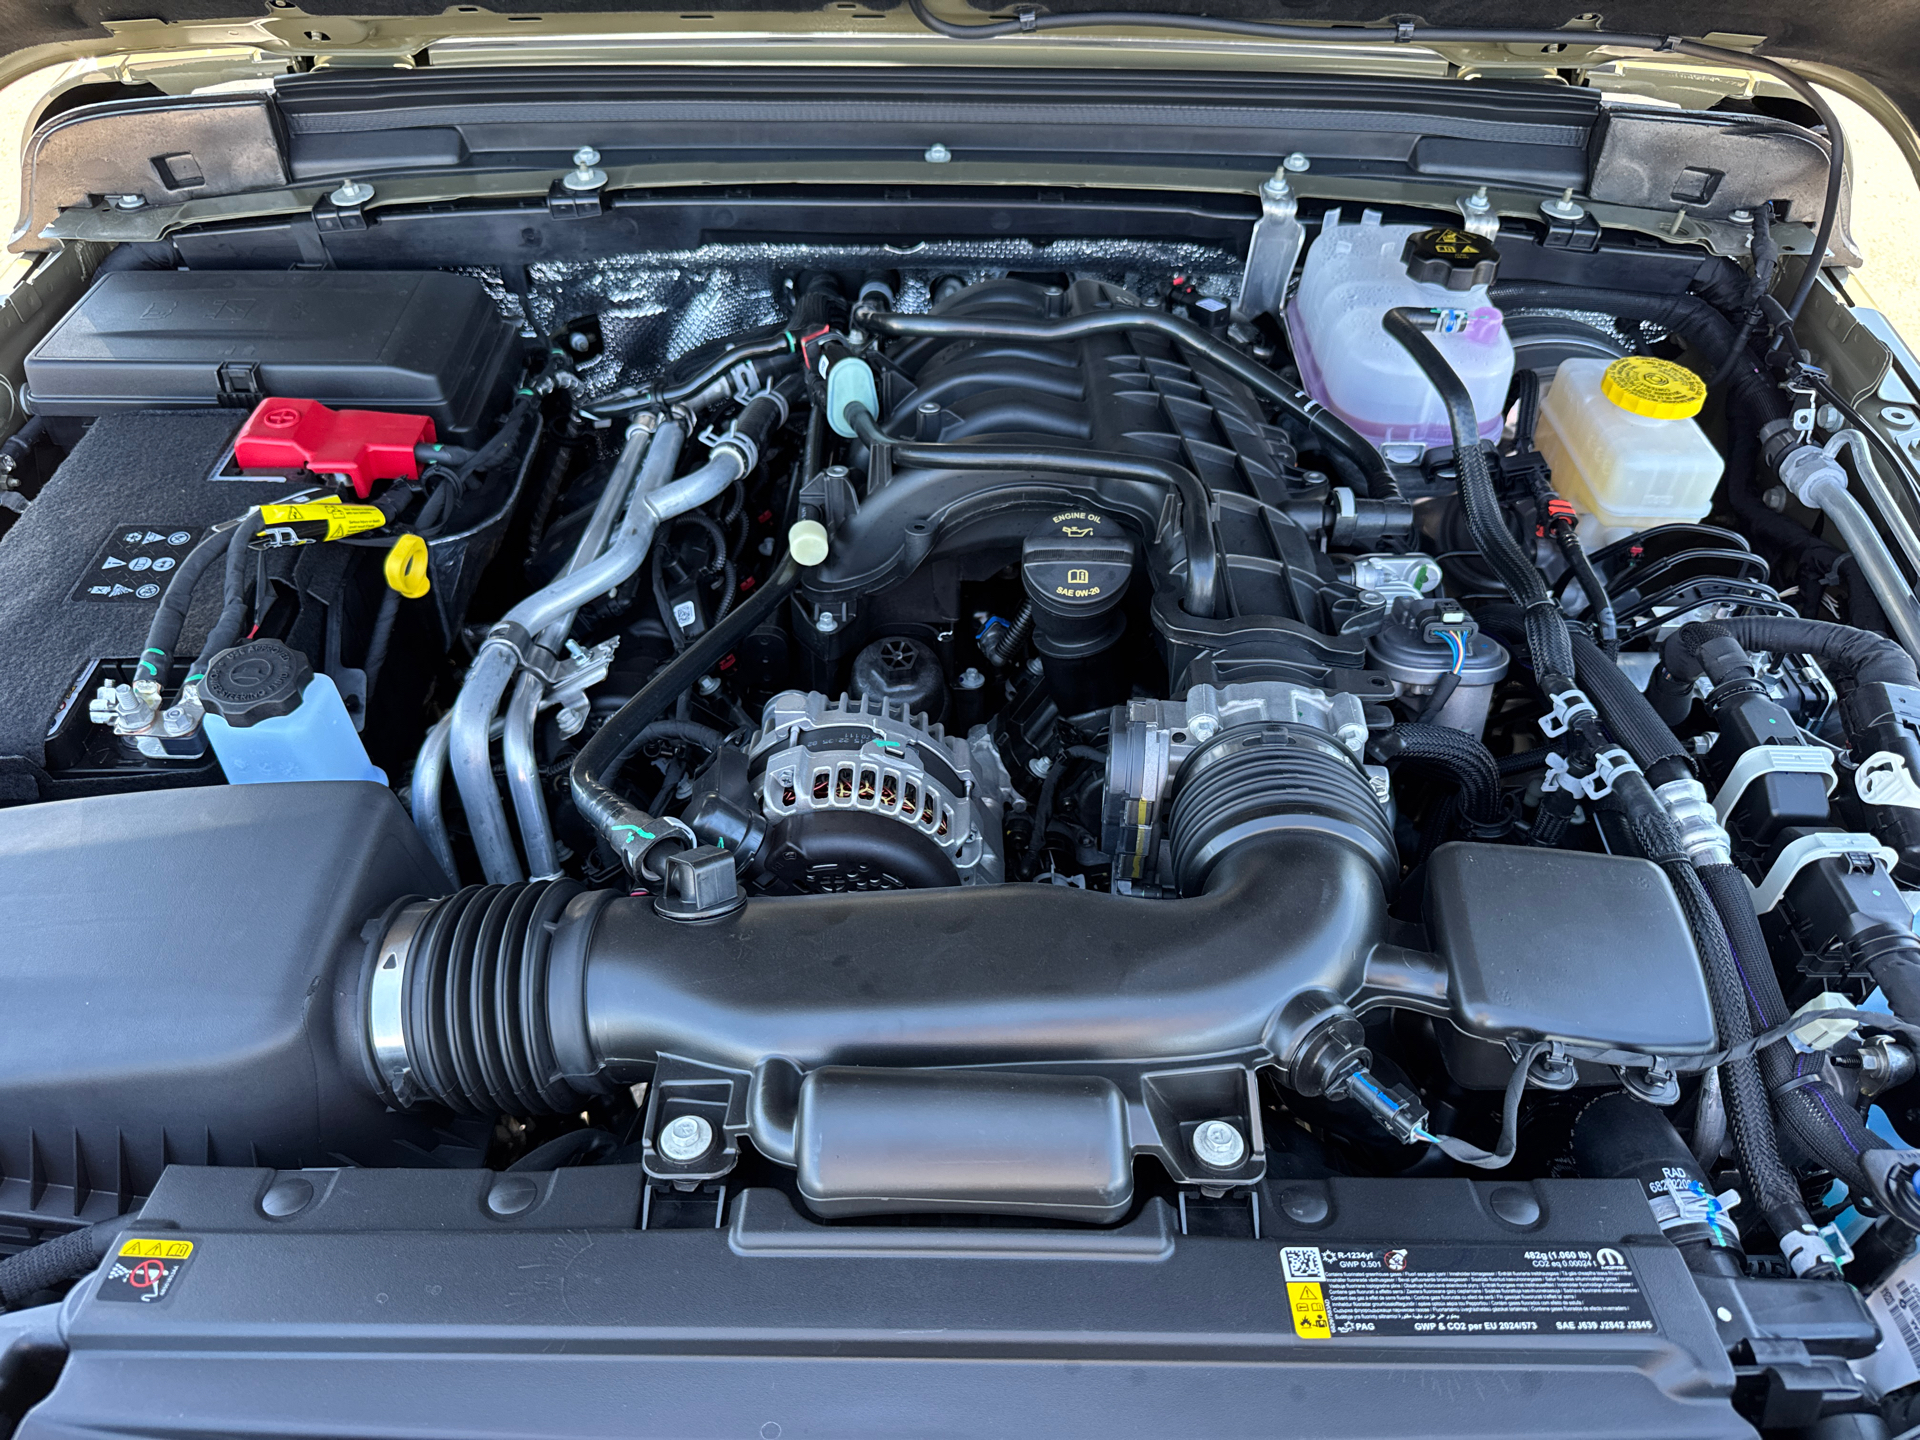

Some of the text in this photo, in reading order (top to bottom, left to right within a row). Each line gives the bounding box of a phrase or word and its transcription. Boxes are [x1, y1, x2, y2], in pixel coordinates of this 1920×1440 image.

[1052, 512, 1101, 524] ENGINE OIL
[1056, 586, 1101, 597] SAE 0W-20
[226, 643, 291, 662] USE APPROVED
[1661, 1167, 1686, 1178] RAD
[1337, 1251, 1374, 1261] R-1234yf
[1524, 1250, 1592, 1261] 482g (1.060 lb)
[1339, 1260, 1382, 1268] GWP 0.501
[1532, 1260, 1550, 1268] CO2
[1551, 1261, 1561, 1269] eq
[1355, 1323, 1376, 1331] PAG
[1414, 1321, 1538, 1332] GWP & CO2 per EU 2024/573
[1555, 1322, 1576, 1330] SAE
[1577, 1322, 1598, 1330] J639
[1599, 1322, 1625, 1330] J2842
